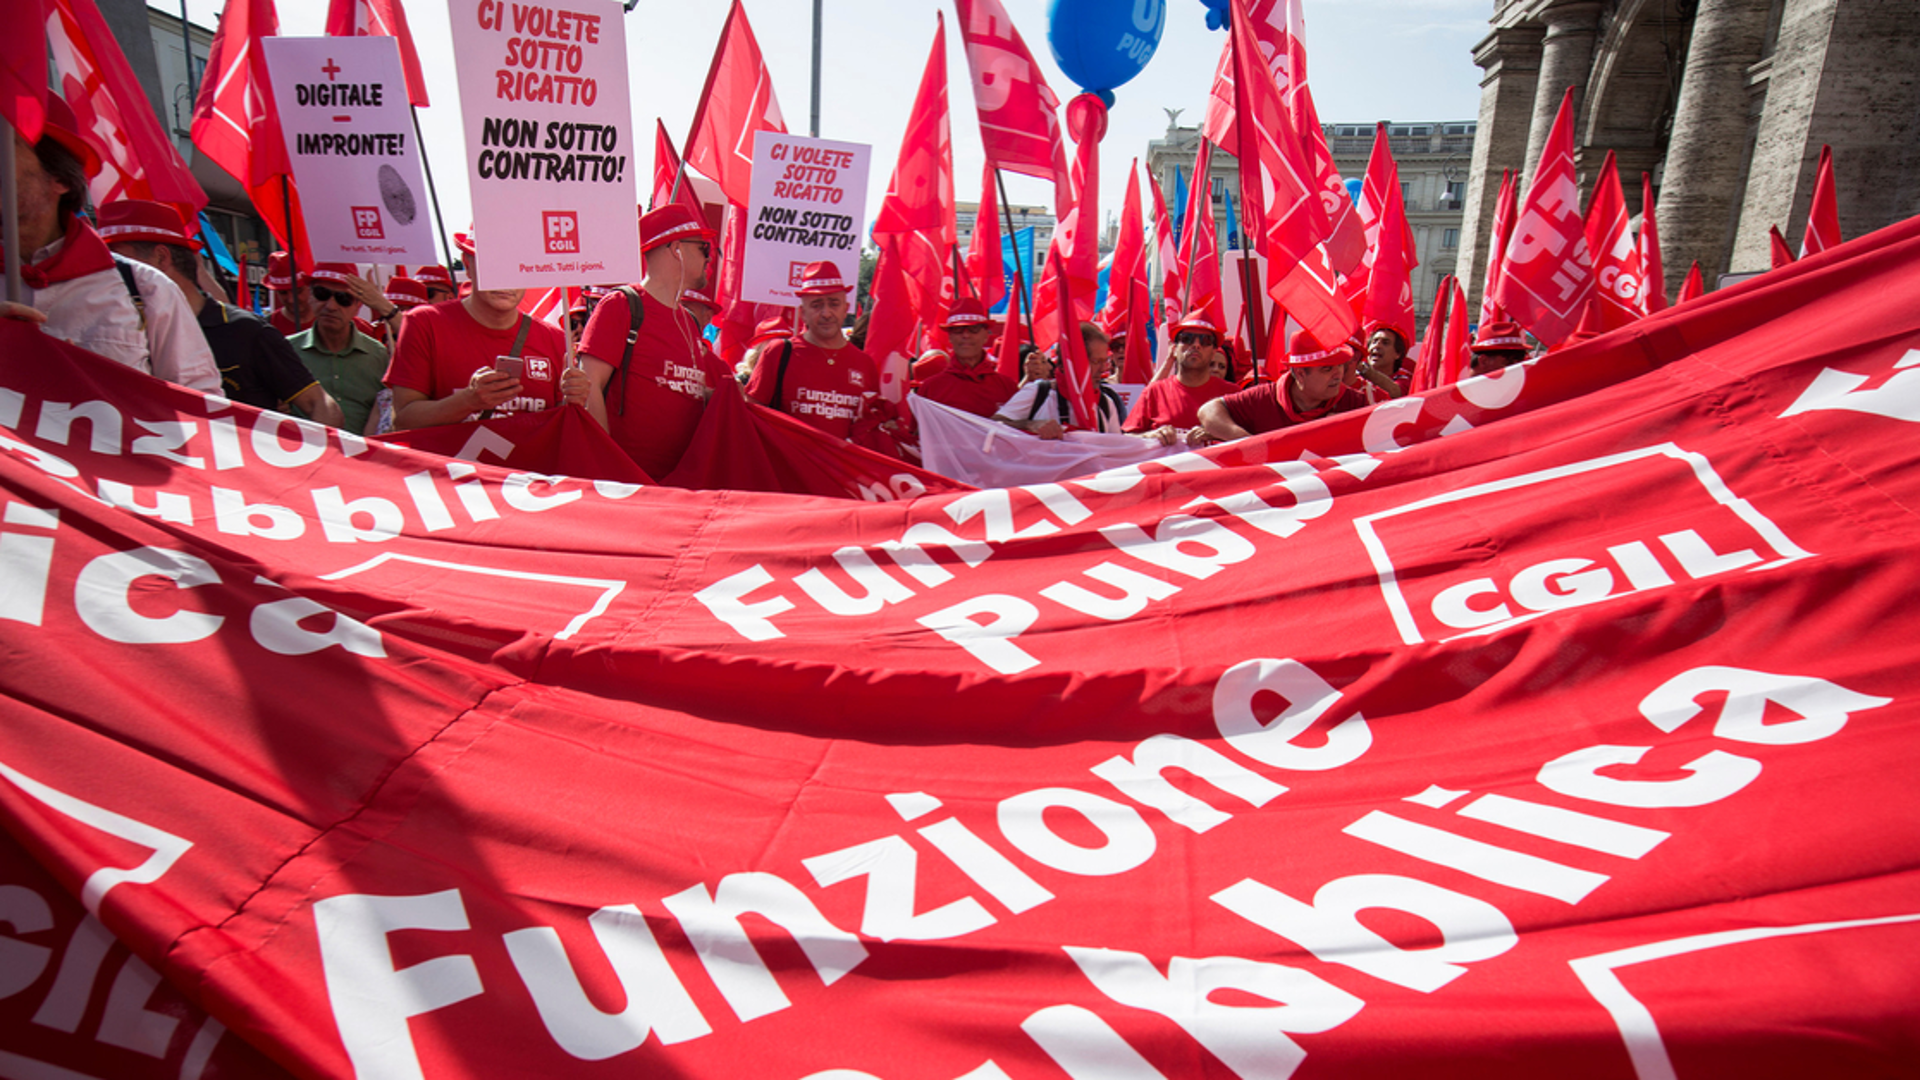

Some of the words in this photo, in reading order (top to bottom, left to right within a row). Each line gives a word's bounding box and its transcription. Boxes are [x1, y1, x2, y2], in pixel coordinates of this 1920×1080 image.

[478, 0, 504, 31] CI
[512, 3, 601, 44] VOLETE
[505, 37, 583, 74] SOTTO
[1116, 32, 1152, 67] PUG
[295, 83, 383, 106] DIGITALE
[496, 70, 597, 107] RICATTO
[297, 134, 405, 156] IMPRONTE!
[482, 117, 538, 148] NON
[544, 121, 617, 153] SOTTO
[478, 149, 626, 183] CONTRATTO!
[770, 143, 788, 161] CI
[792, 146, 854, 169] VOLETE
[783, 164, 836, 185] SOTTO
[774, 181, 843, 204] RICATTO
[355, 210, 379, 227] FP
[547, 216, 575, 238] FP
[758, 206, 797, 225] NON
[799, 211, 852, 232] SOTTO
[359, 229, 381, 237] CGIL
[753, 223, 856, 250] CONTRATTO!
[549, 240, 576, 251] CGIL
[519, 263, 534, 273] Per
[535, 263, 556, 273] tutti.
[557, 262, 574, 272] Tutti
[580, 261, 605, 273] giorni.
[529, 359, 548, 370] FP
[797, 387, 860, 406] Funzione
[791, 400, 856, 420] Partigian
[1431, 529, 1763, 628] CGIL
[313, 658, 1373, 1080] Funzione
